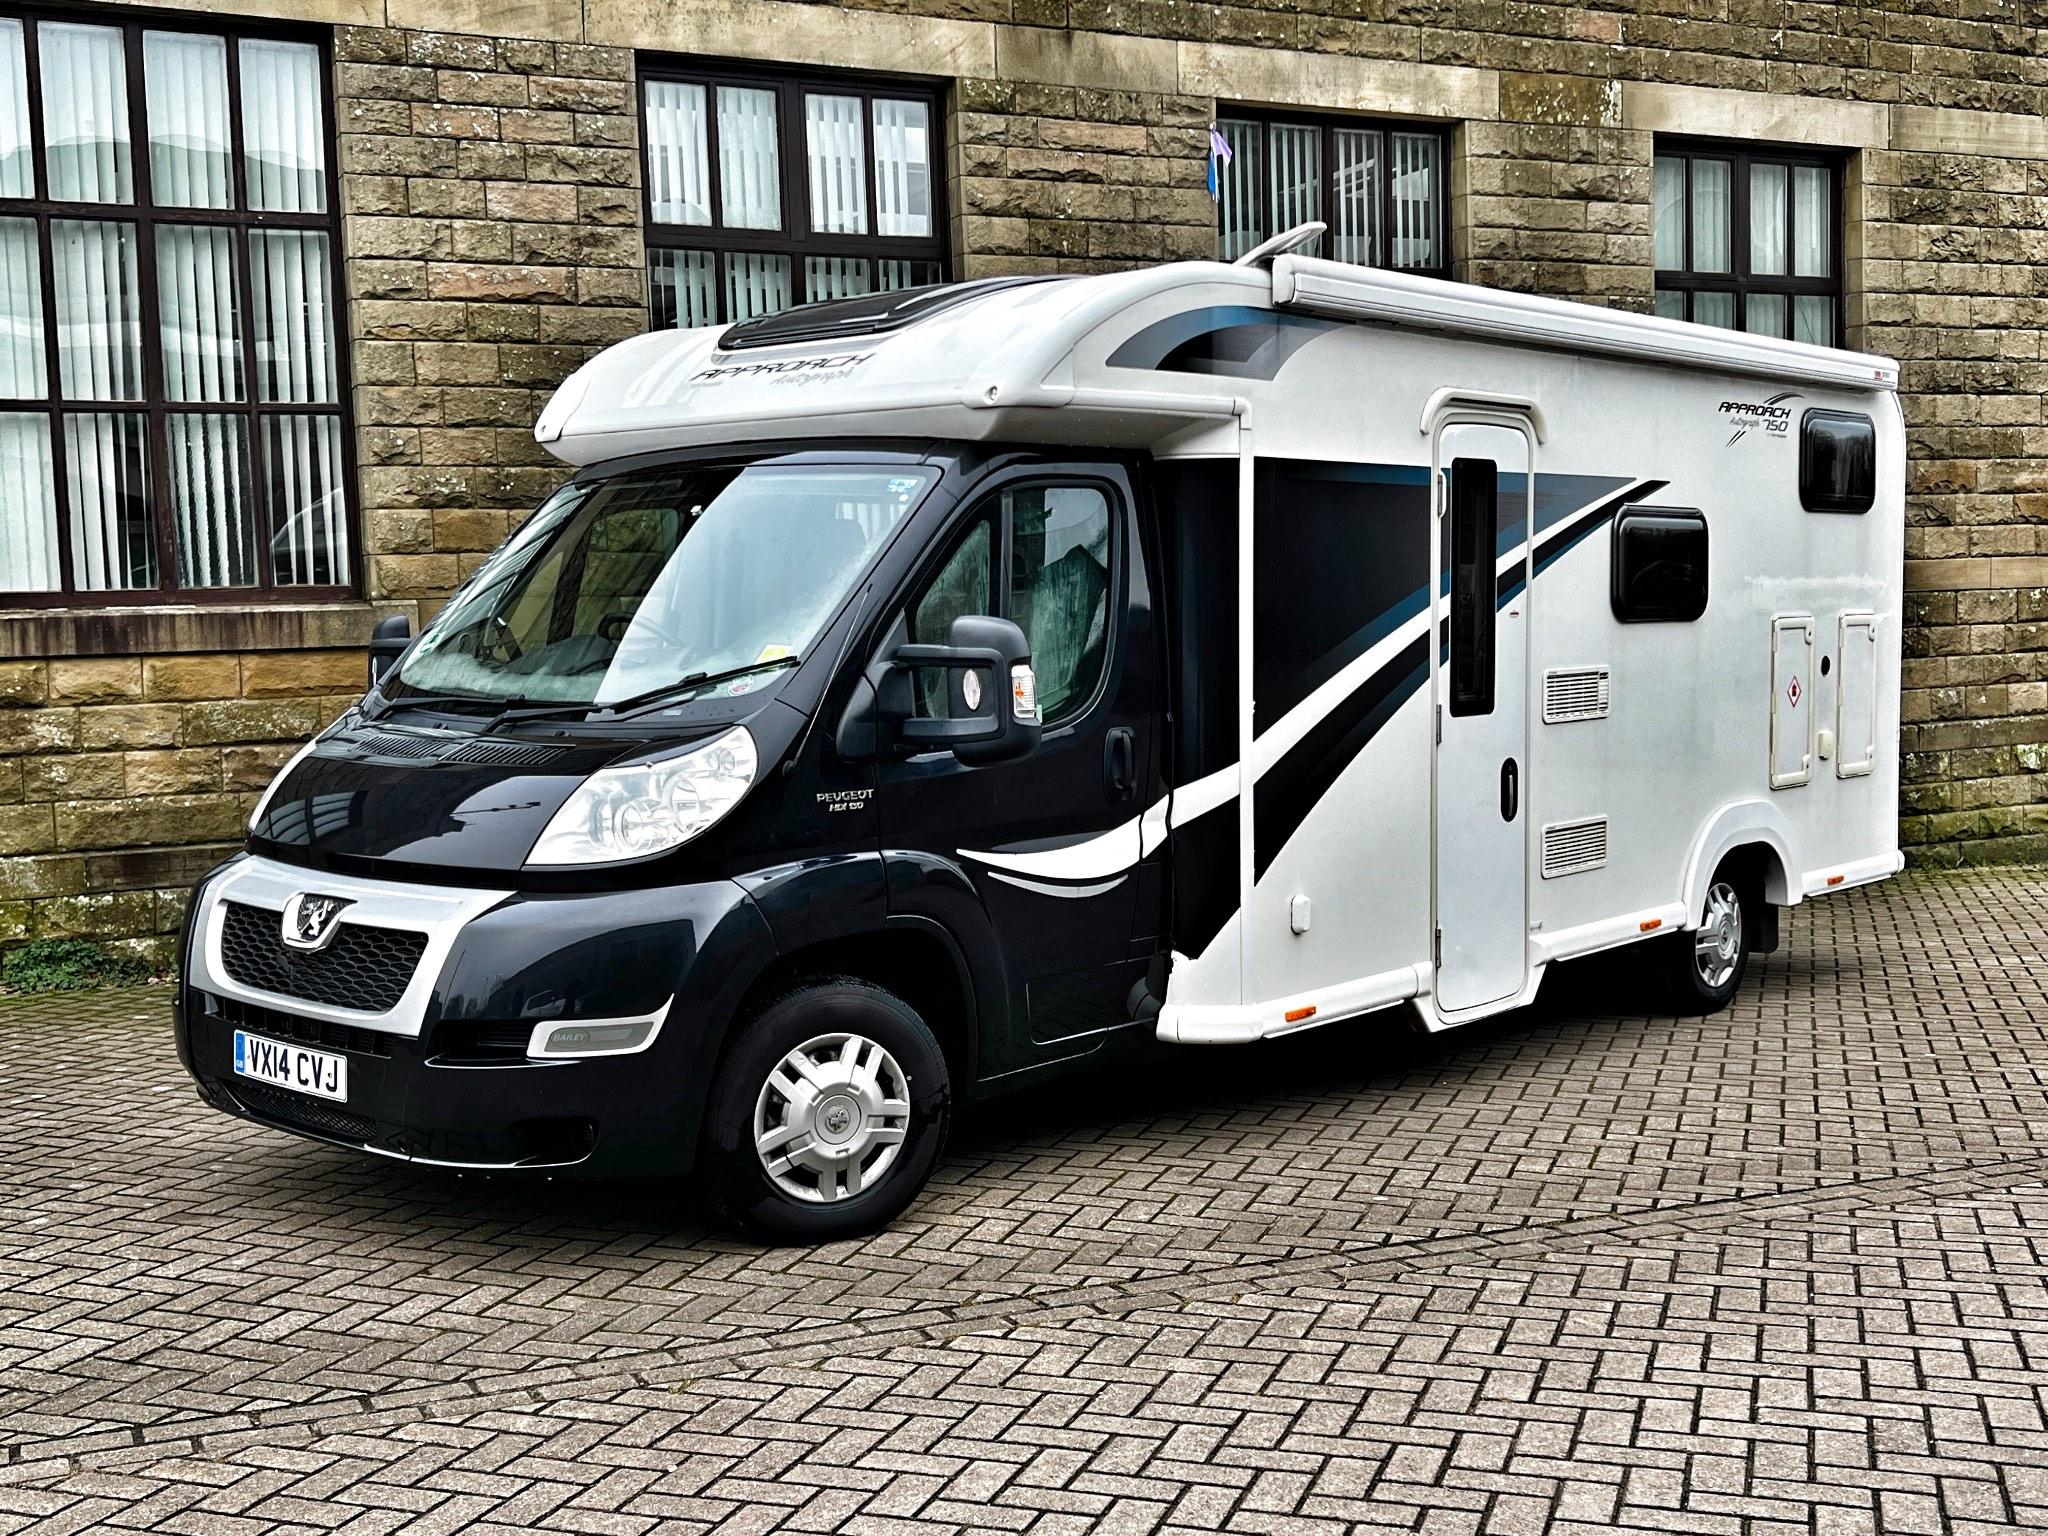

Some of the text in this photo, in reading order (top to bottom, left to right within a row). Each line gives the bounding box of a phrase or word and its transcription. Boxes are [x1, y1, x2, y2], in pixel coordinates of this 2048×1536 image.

[689, 352, 877, 382] APPROACH
[1718, 401, 1791, 419] APPROACH
[1729, 416, 1788, 432] Autograph 750
[816, 789, 874, 803] PEUGEOT
[553, 1032, 587, 1042] BAILEY
[250, 1039, 338, 1093] VX14 CVJ
